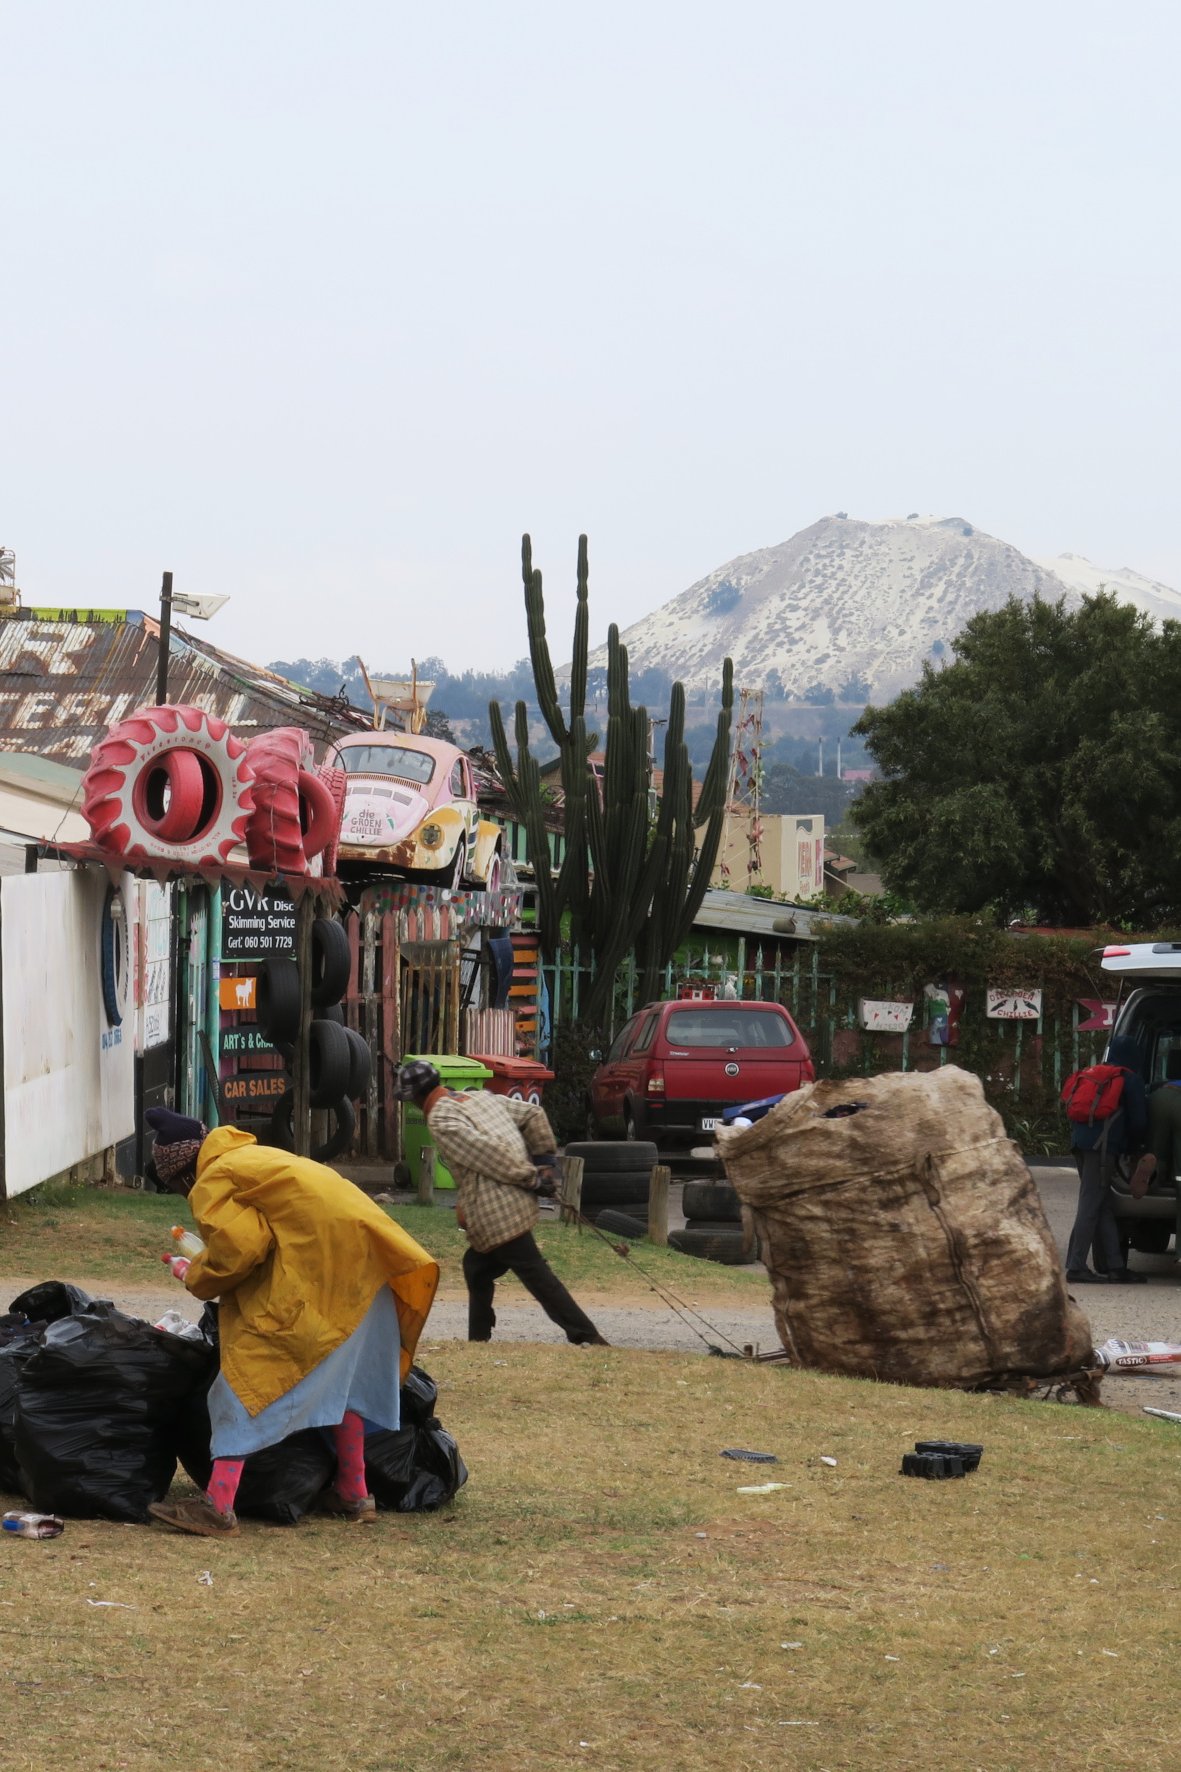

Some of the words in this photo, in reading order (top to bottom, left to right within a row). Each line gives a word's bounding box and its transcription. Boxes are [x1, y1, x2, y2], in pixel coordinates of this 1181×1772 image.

[359, 809, 376, 819] die
[351, 817, 382, 828] GROEN
[350, 826, 383, 836] CHILLIE
[273, 900, 294, 911] Disc
[228, 915, 266, 932] Skimming
[267, 915, 296, 929] Service
[244, 936, 259, 948] 060
[259, 936, 272, 948] 501
[275, 936, 293, 948] 7729
[248, 1032, 254, 1049] &
[224, 1081, 246, 1098] CAR
[249, 1077, 286, 1096] SALES
[1117, 1356, 1144, 1366] TASTIC
